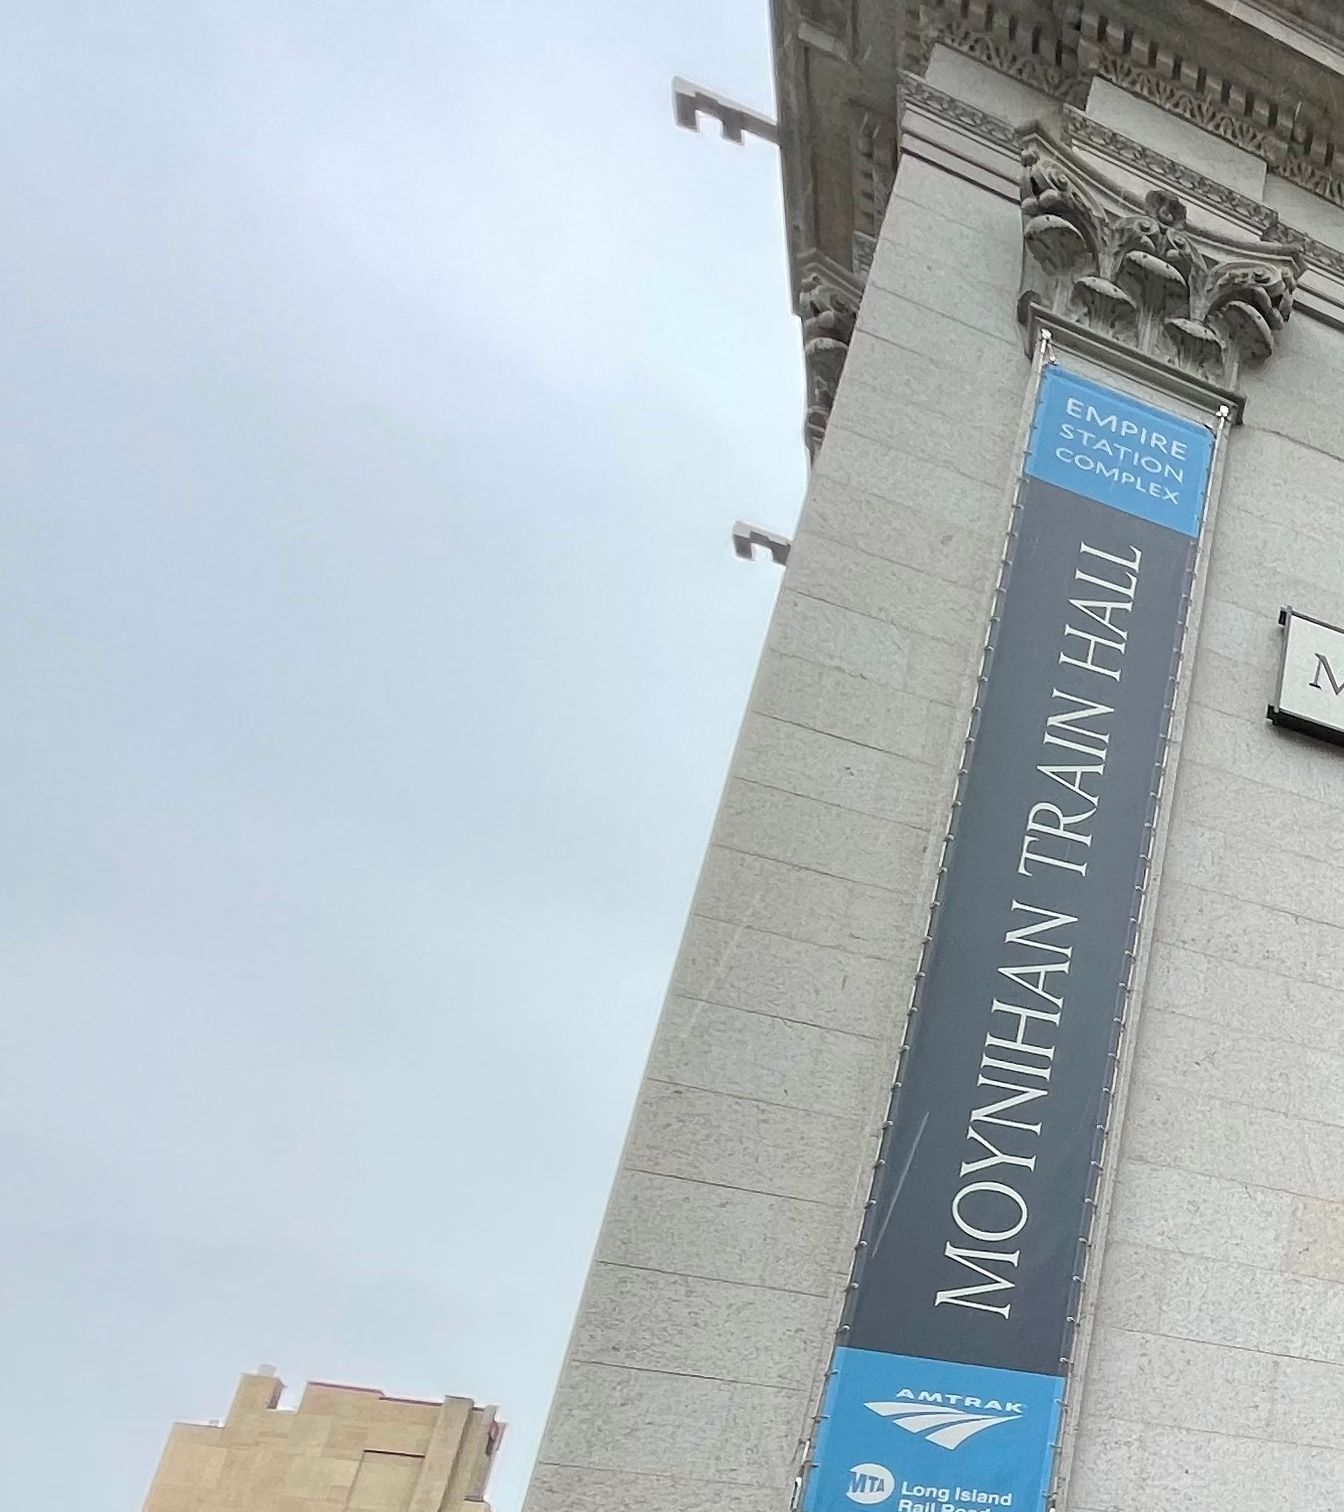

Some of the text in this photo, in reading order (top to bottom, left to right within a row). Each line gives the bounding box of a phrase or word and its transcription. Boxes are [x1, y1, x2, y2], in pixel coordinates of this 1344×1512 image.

[1059, 423, 1185, 483] STATION
[1065, 397, 1187, 460] EMPIRE
[1055, 447, 1180, 504] COMPLEX
[934, 541, 1142, 1320] MOYNIHAN TRAIN HALL
[896, 1388, 1024, 1413] AMTRAK
[901, 1481, 1013, 1506] Long Island
